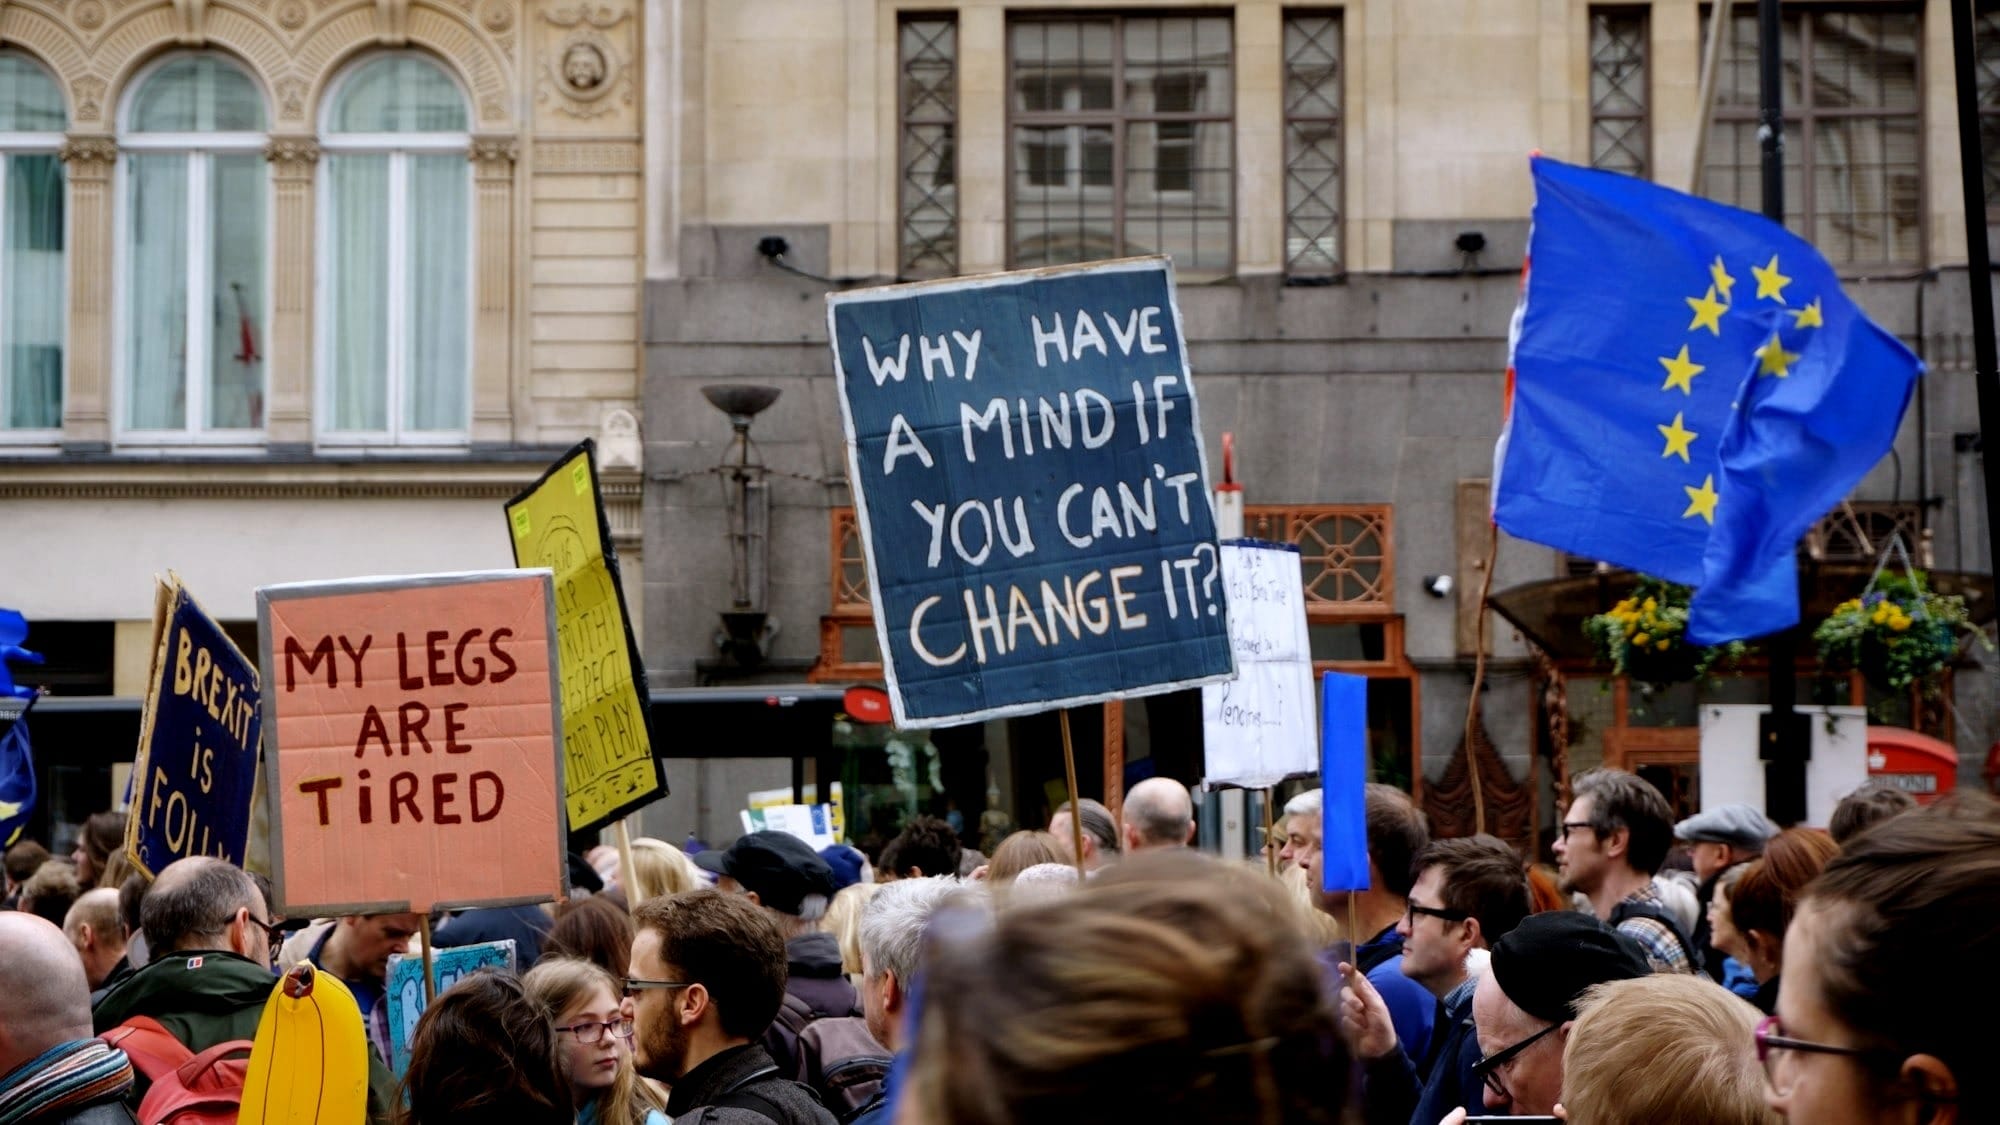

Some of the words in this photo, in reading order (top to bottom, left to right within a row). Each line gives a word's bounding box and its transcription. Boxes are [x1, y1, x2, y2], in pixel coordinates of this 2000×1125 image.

[862, 329, 982, 386] WHY
[1031, 306, 1168, 368] HAVE
[882, 413, 935, 475] A
[960, 388, 1117, 462] MIND
[1132, 376, 1178, 445] IF
[911, 496, 1035, 568] YOU
[1057, 463, 1199, 549] CAN'T
[909, 565, 1148, 667] CHANGE
[1161, 542, 1219, 621] IT?
[284, 634, 373, 692] MY
[396, 627, 517, 690] LEGS
[354, 701, 473, 759] ARE
